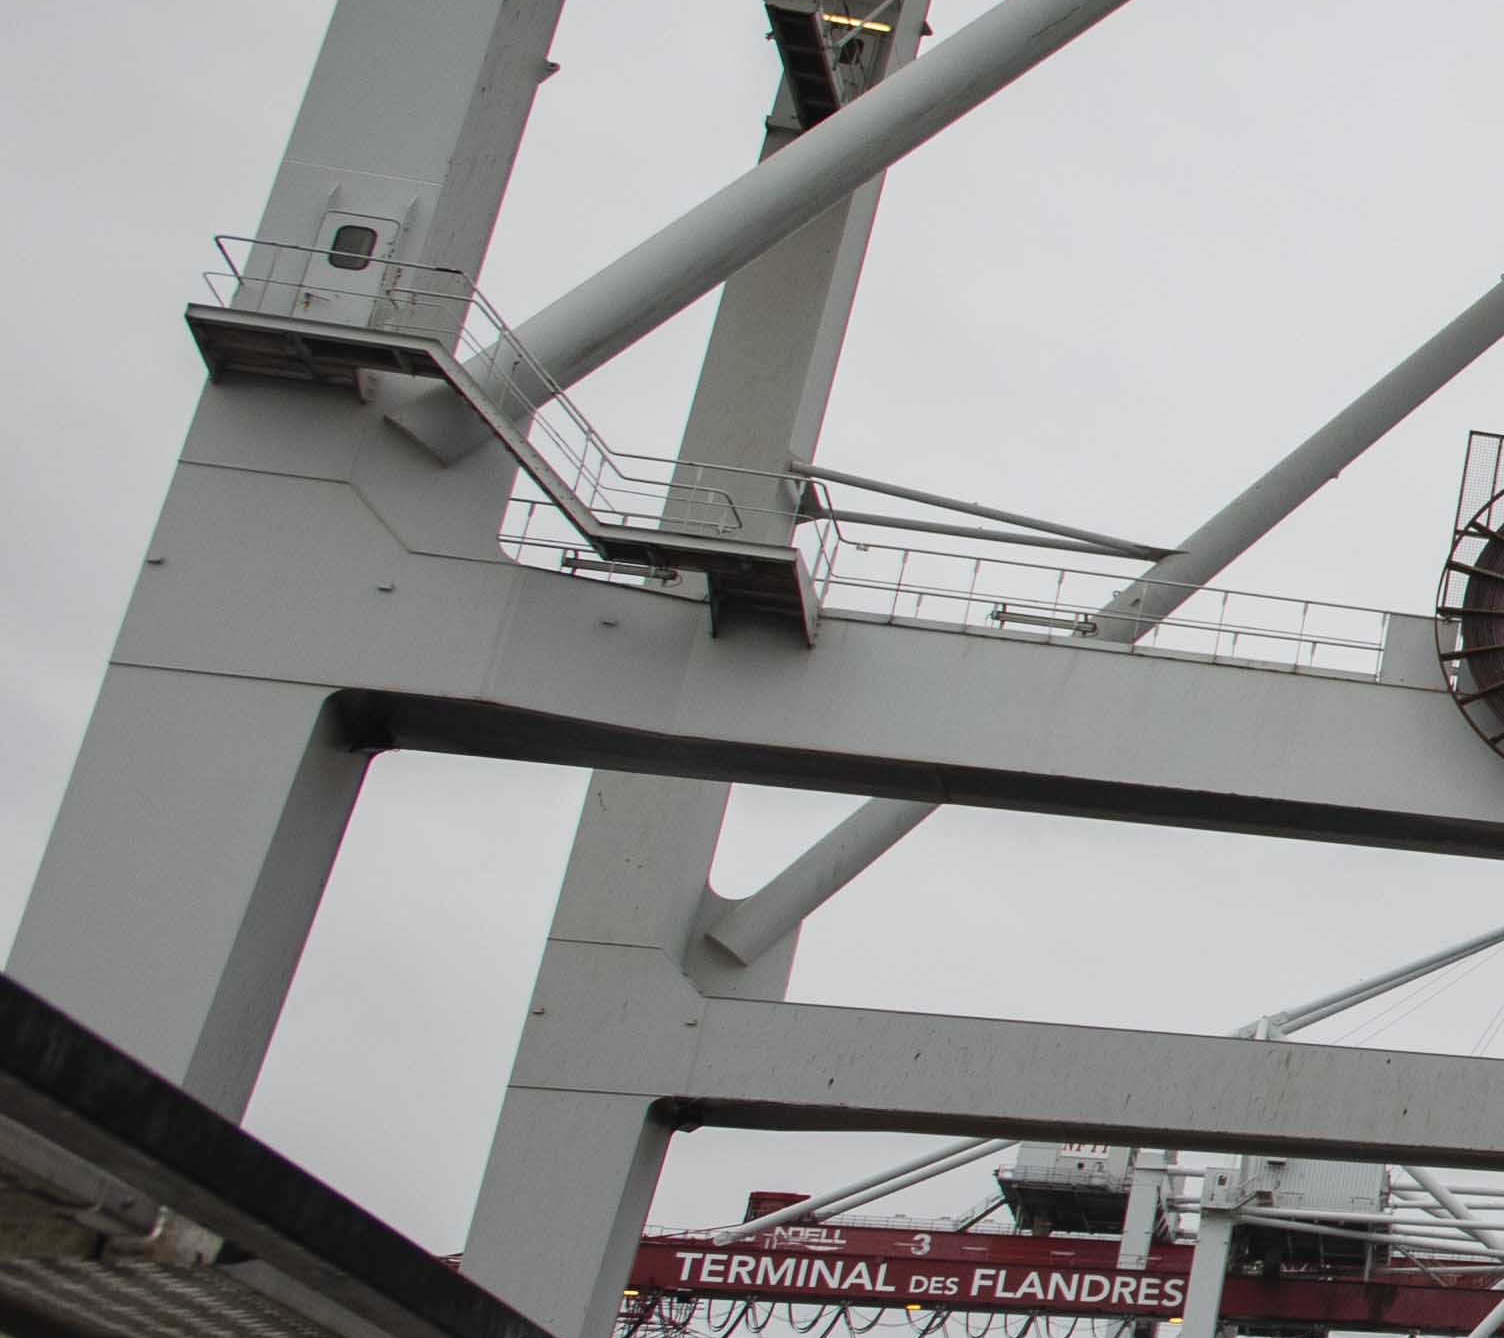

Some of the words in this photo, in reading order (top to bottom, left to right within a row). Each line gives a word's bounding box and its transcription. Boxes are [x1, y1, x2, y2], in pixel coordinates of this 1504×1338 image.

[911, 1233, 932, 1255] 3
[676, 1252, 896, 1292] TERMINAL
[909, 1276, 959, 1295] DES
[970, 1269, 1185, 1308] FLANDRES
